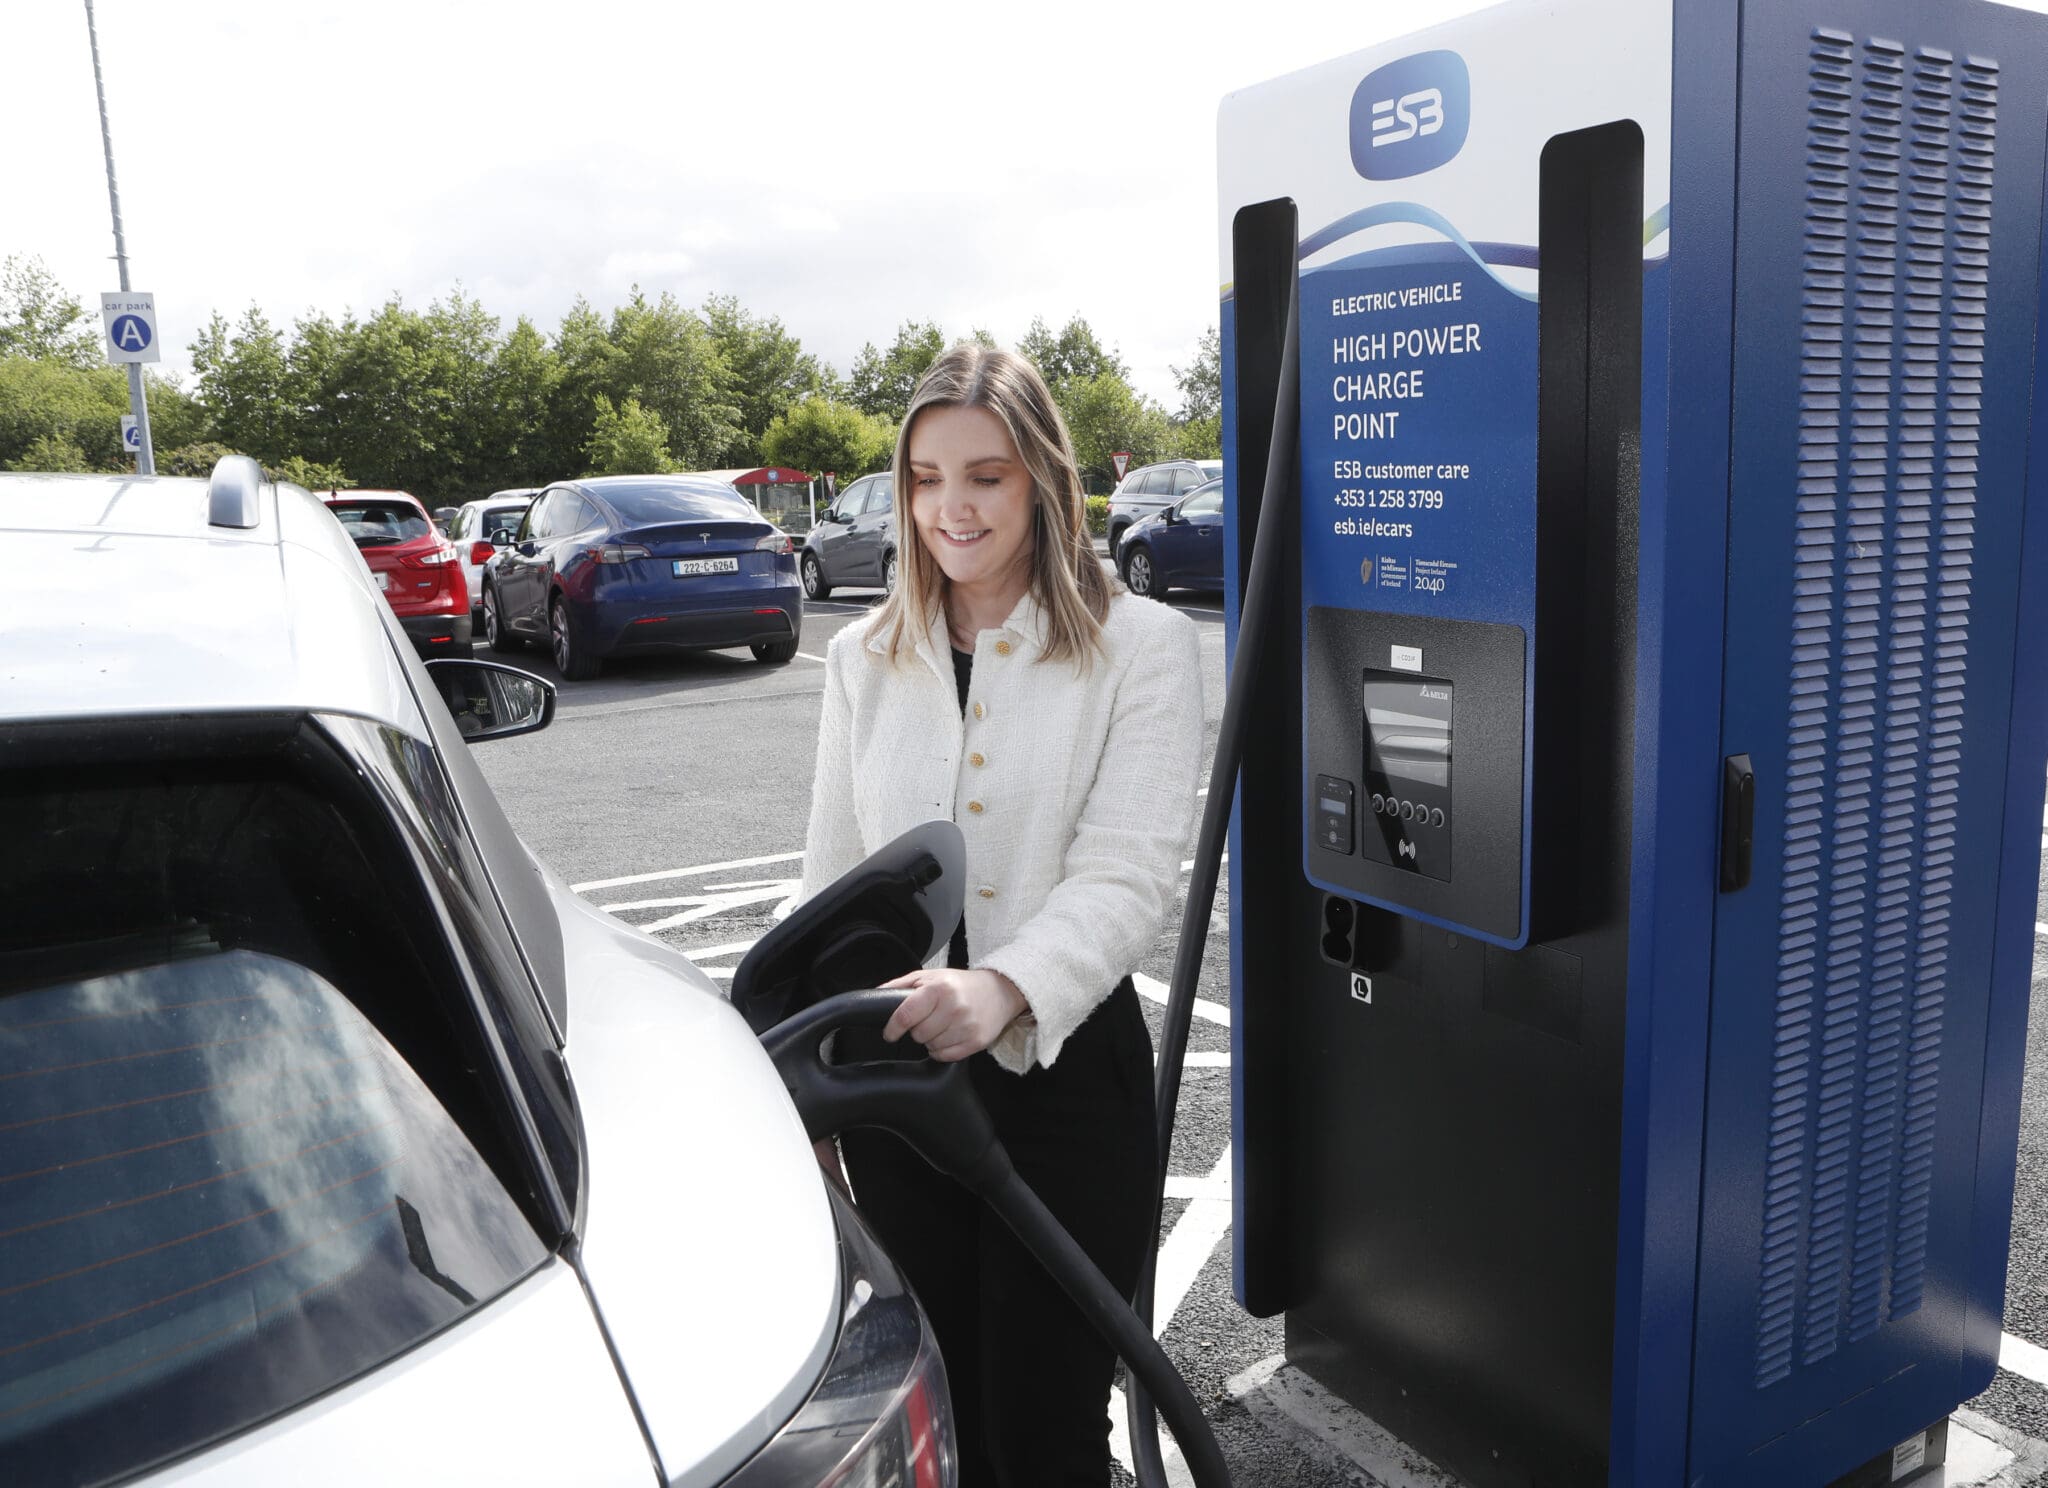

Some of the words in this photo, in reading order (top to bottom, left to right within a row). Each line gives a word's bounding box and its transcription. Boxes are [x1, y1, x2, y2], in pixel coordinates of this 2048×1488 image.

[1372, 88, 1443, 148] ESB
[105, 303, 123, 311] car
[126, 302, 152, 312] park
[1332, 290, 1397, 316] ELECTRIC
[1399, 282, 1462, 307] VEHICLE
[120, 319, 145, 348] A
[1333, 333, 1385, 364] HIGH
[1393, 323, 1481, 359] POWER
[1333, 370, 1424, 403] CHARGE
[1334, 412, 1399, 441] POINT
[1334, 461, 1362, 479] ESB
[1364, 463, 1433, 480] customer
[1436, 463, 1470, 480] care
[1334, 490, 1365, 507] +353
[1368, 490, 1376, 508] 1
[1379, 490, 1405, 508] 258
[1408, 491, 1443, 509] 3799
[1334, 518, 1413, 538] esb.ie/ecars
[684, 560, 734, 573] 222-C-6264
[1414, 577, 1445, 596] 2040
[1357, 980, 1366, 996] L
